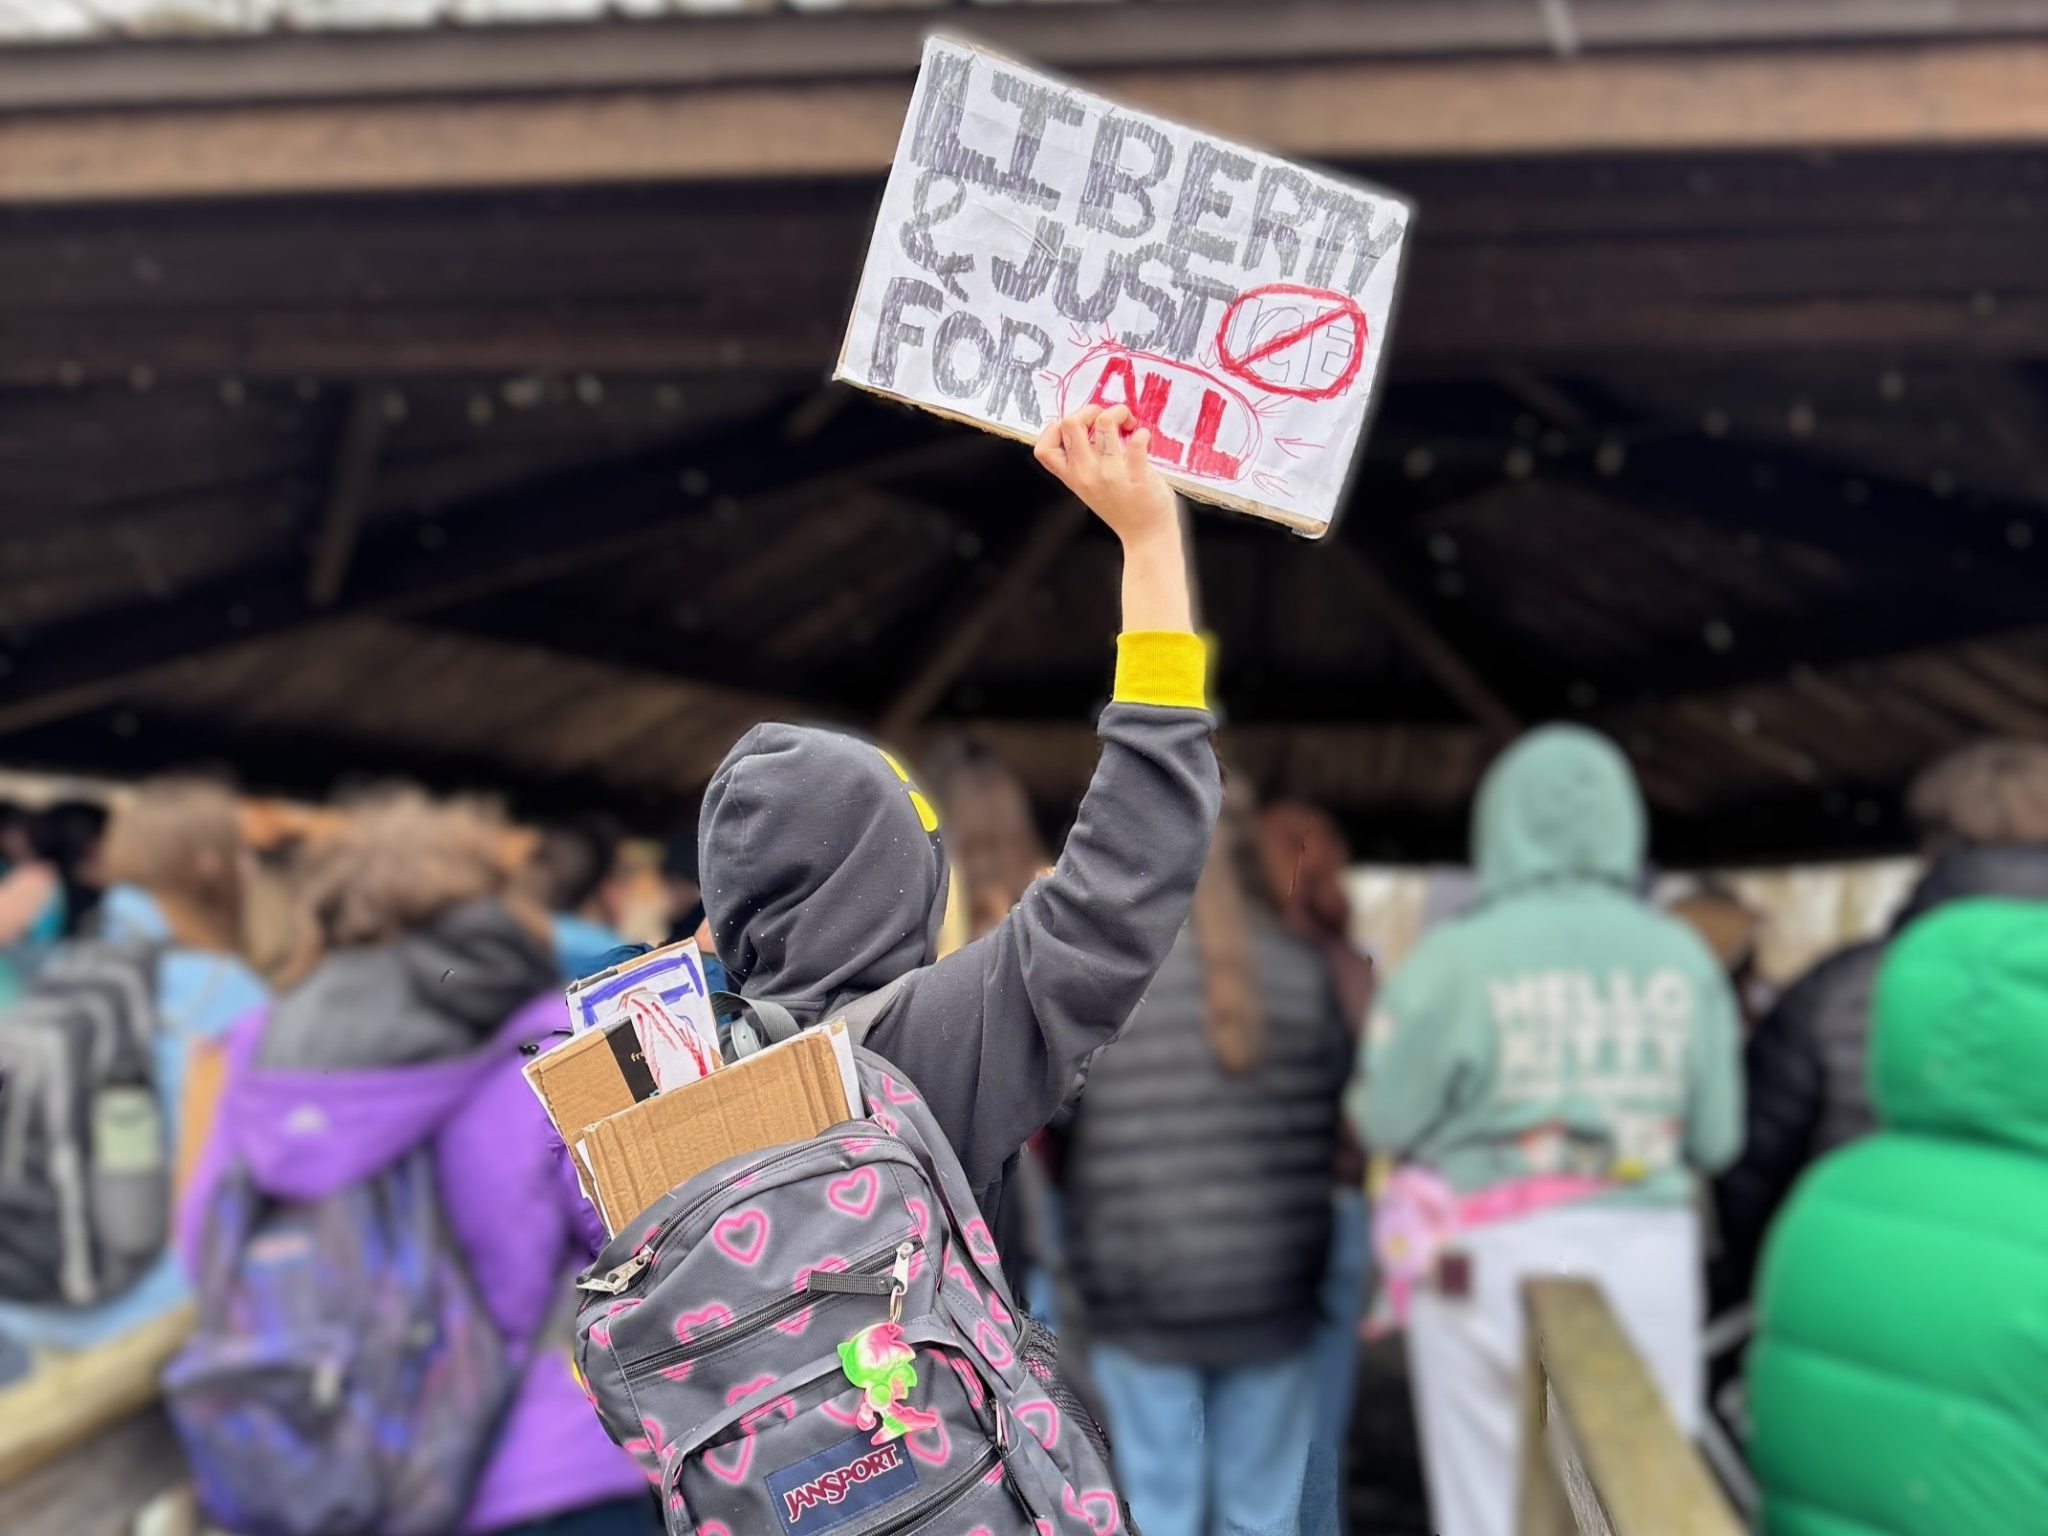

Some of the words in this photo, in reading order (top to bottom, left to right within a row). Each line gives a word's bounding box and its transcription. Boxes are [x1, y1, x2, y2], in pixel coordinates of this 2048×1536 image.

[910, 50, 1405, 296] LIBERTY
[899, 169, 976, 302] &
[867, 276, 1055, 427] FOR
[1087, 356, 1241, 481] ALL
[1488, 970, 1692, 1028] HELLO
[1499, 1028, 1688, 1080] KITTY
[783, 1444, 900, 1522] JANSPORT
